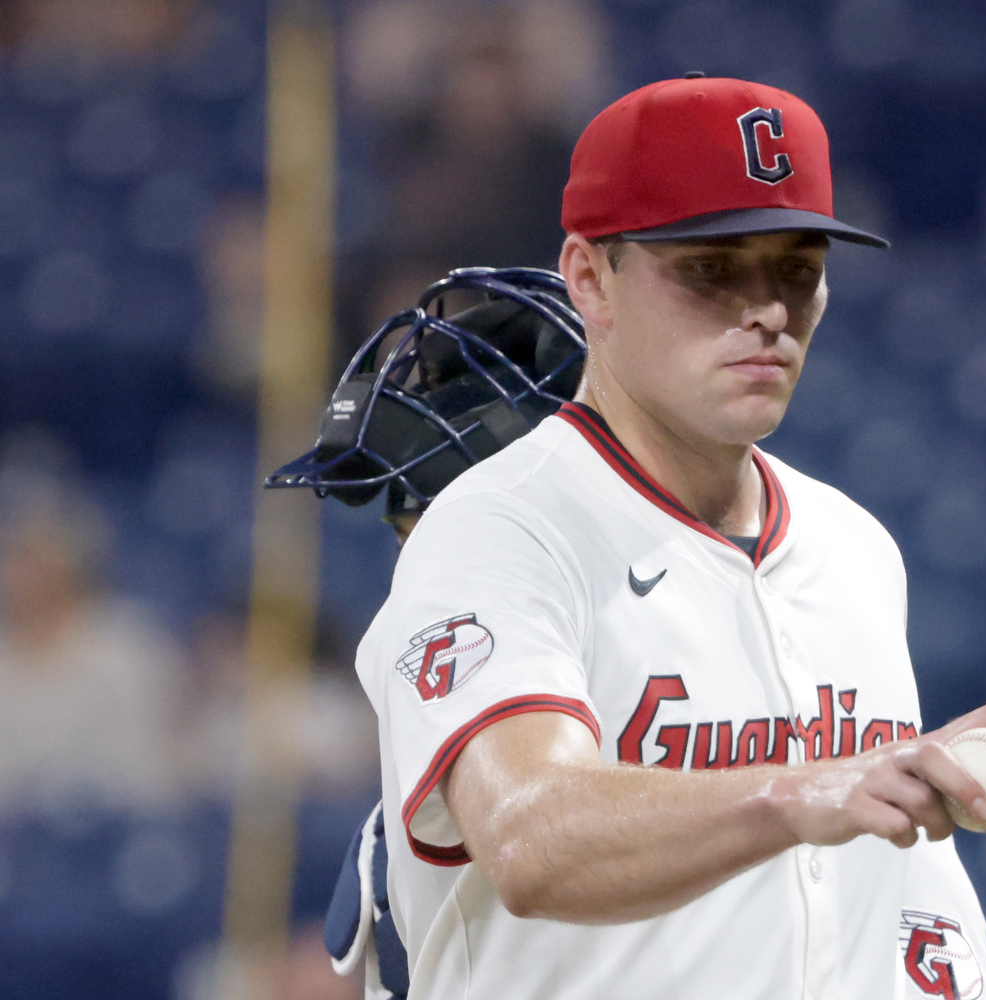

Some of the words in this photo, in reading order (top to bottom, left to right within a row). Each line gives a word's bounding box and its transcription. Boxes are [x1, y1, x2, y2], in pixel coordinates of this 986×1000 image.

[736, 106, 795, 186] C
[414, 626, 457, 702] G
[616, 673, 923, 771] Guardian
